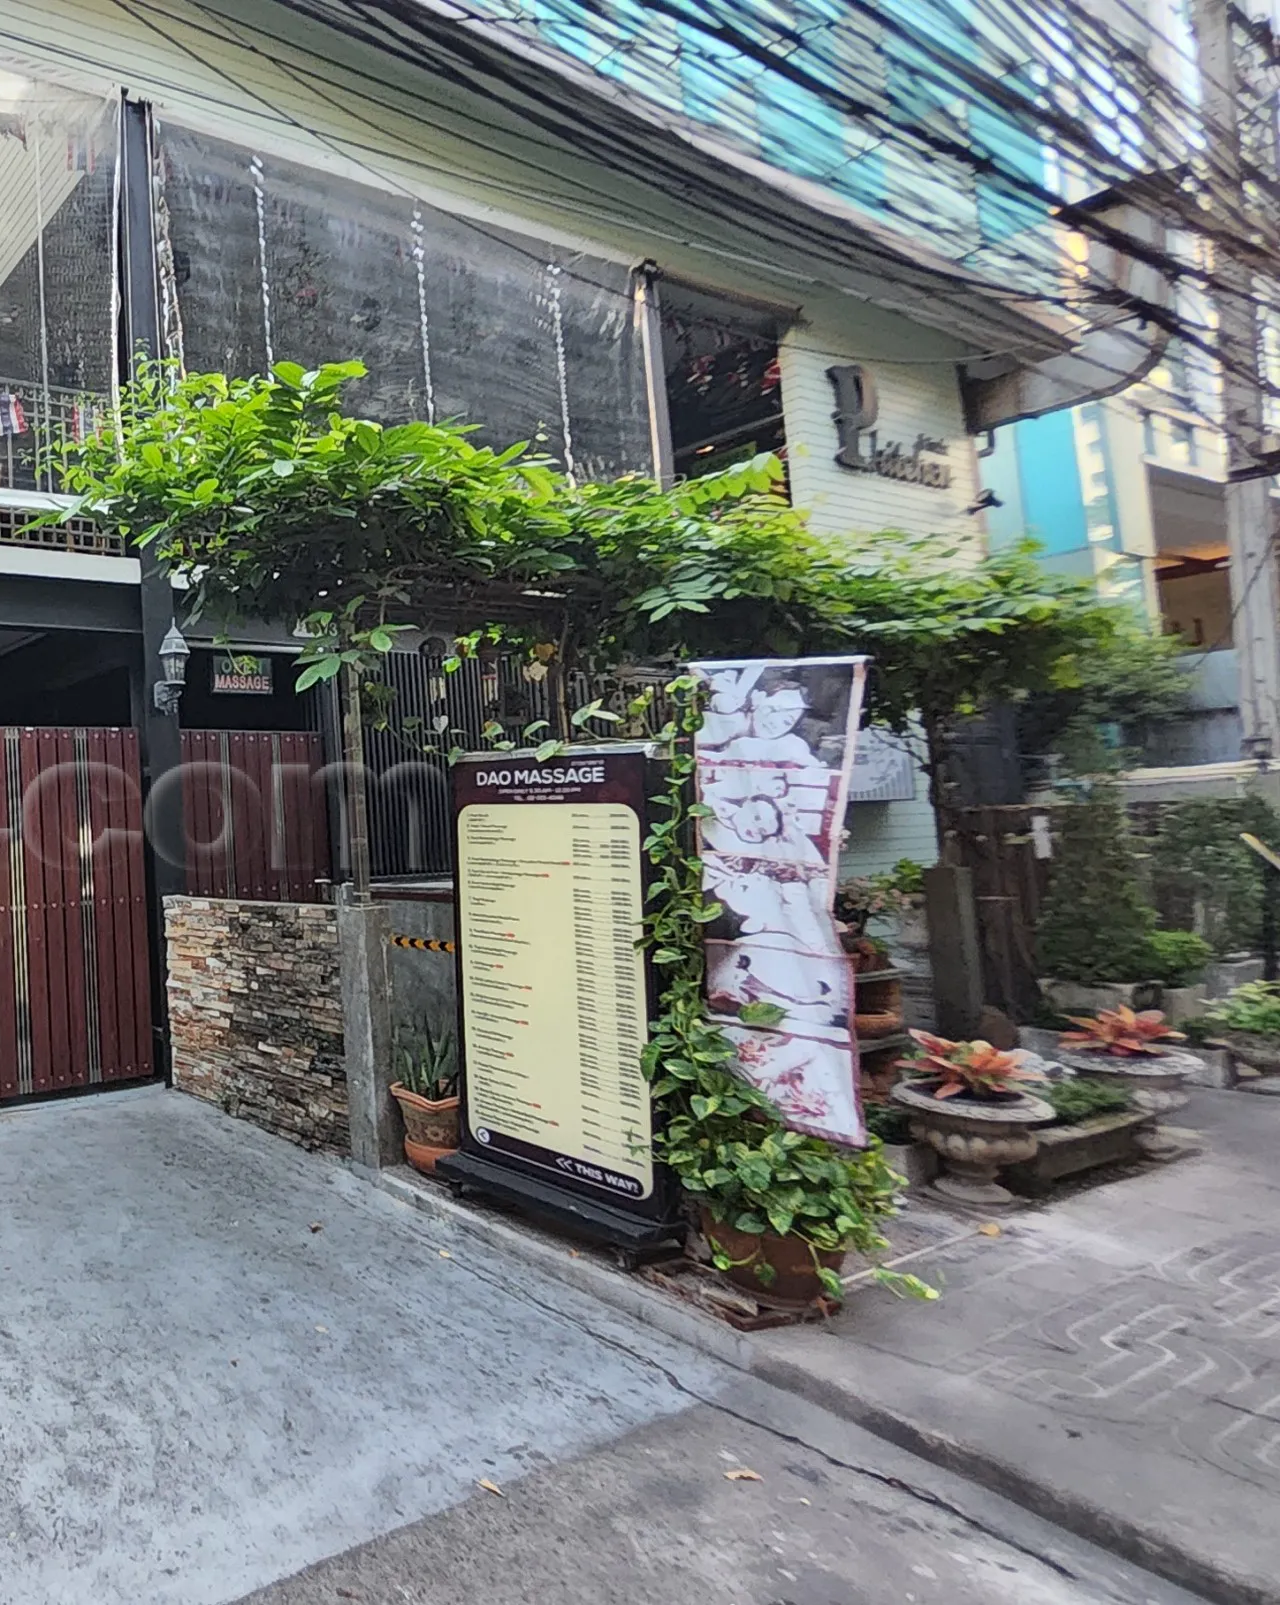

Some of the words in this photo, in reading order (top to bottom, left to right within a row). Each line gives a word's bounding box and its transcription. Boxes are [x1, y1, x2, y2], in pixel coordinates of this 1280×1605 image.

[214, 674, 270, 690] MASSAGE
[476, 771, 512, 786] DAO
[514, 766, 605, 785] MASSAGE
[574, 1163, 603, 1181] THIS
